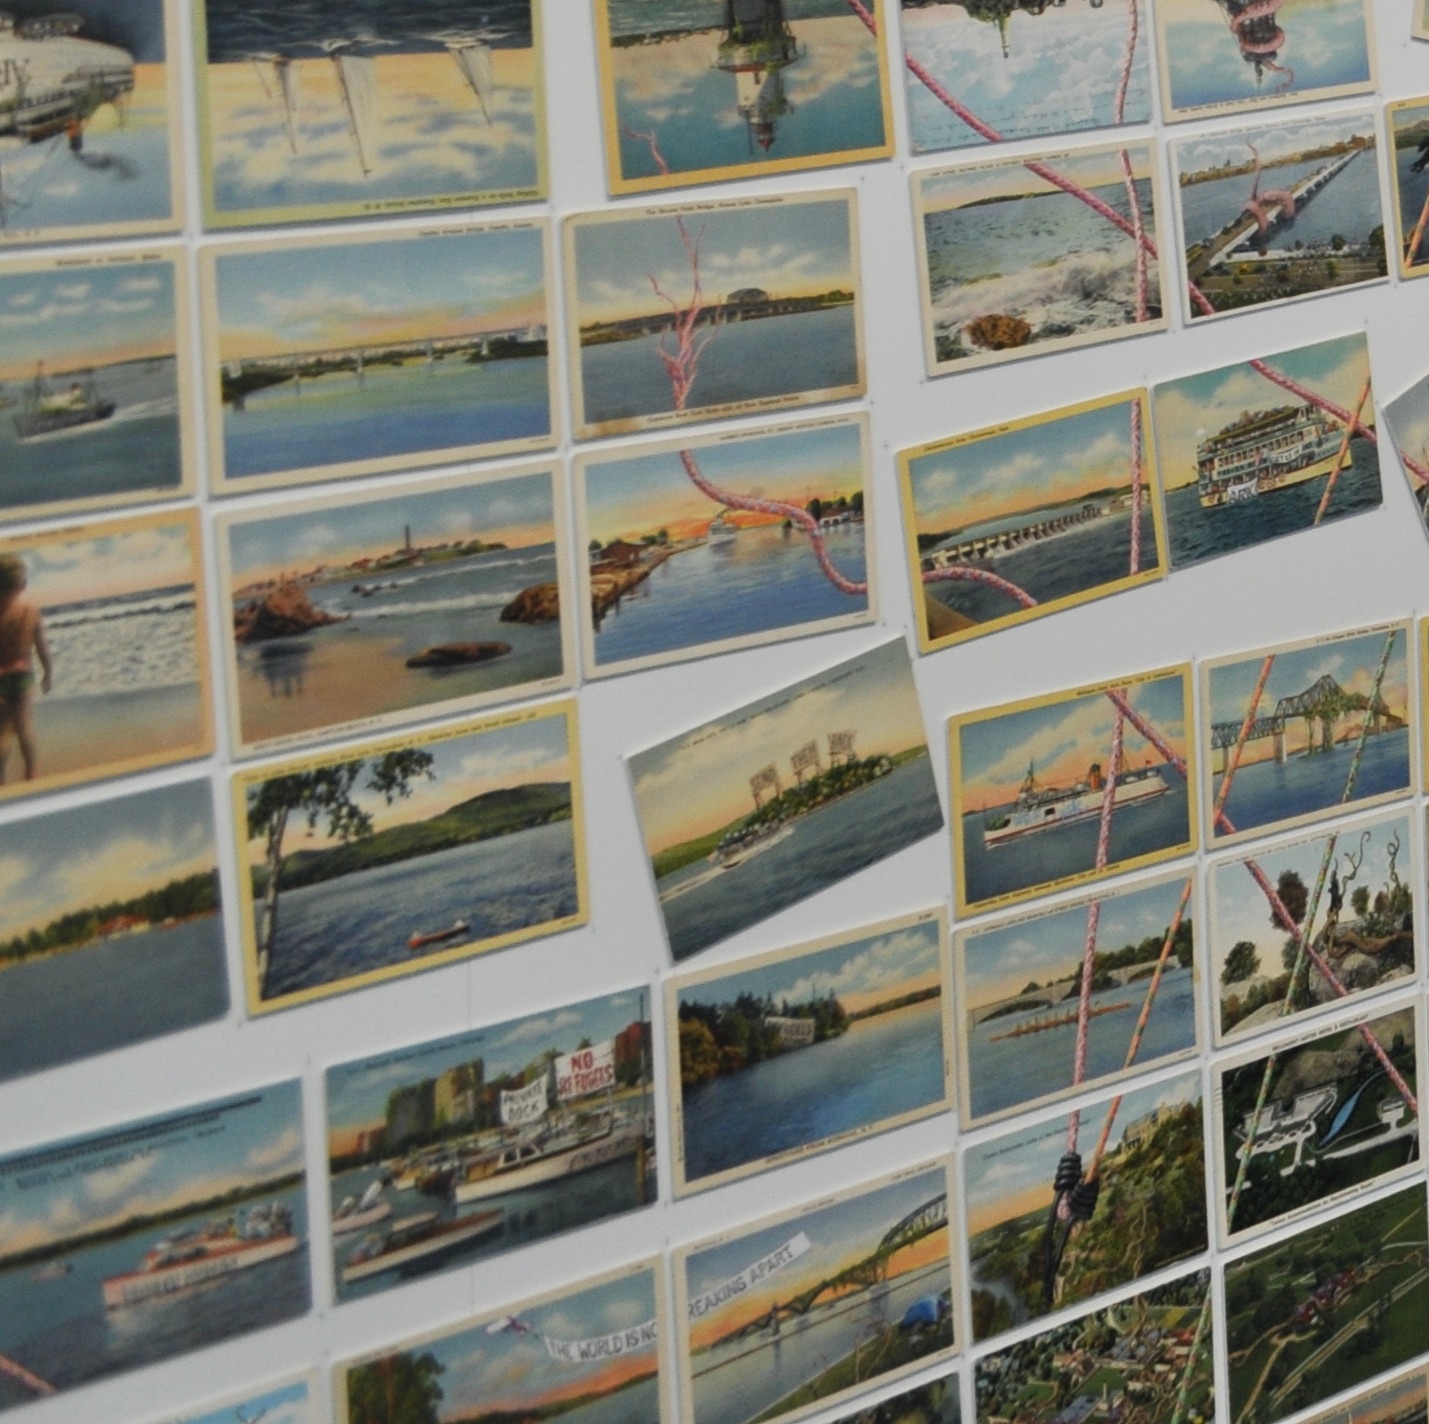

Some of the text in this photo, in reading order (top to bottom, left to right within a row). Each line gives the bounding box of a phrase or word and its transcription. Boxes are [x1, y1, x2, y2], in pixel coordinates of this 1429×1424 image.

[569, 1050, 594, 1073] NO
[558, 1063, 614, 1096] REFUGEES
[508, 1102, 540, 1121] DOCK
[687, 1243, 793, 1320] REAKING APART
[549, 1339, 575, 1361] THE
[579, 1335, 625, 1360] WORLD
[625, 1331, 641, 1349] IS
